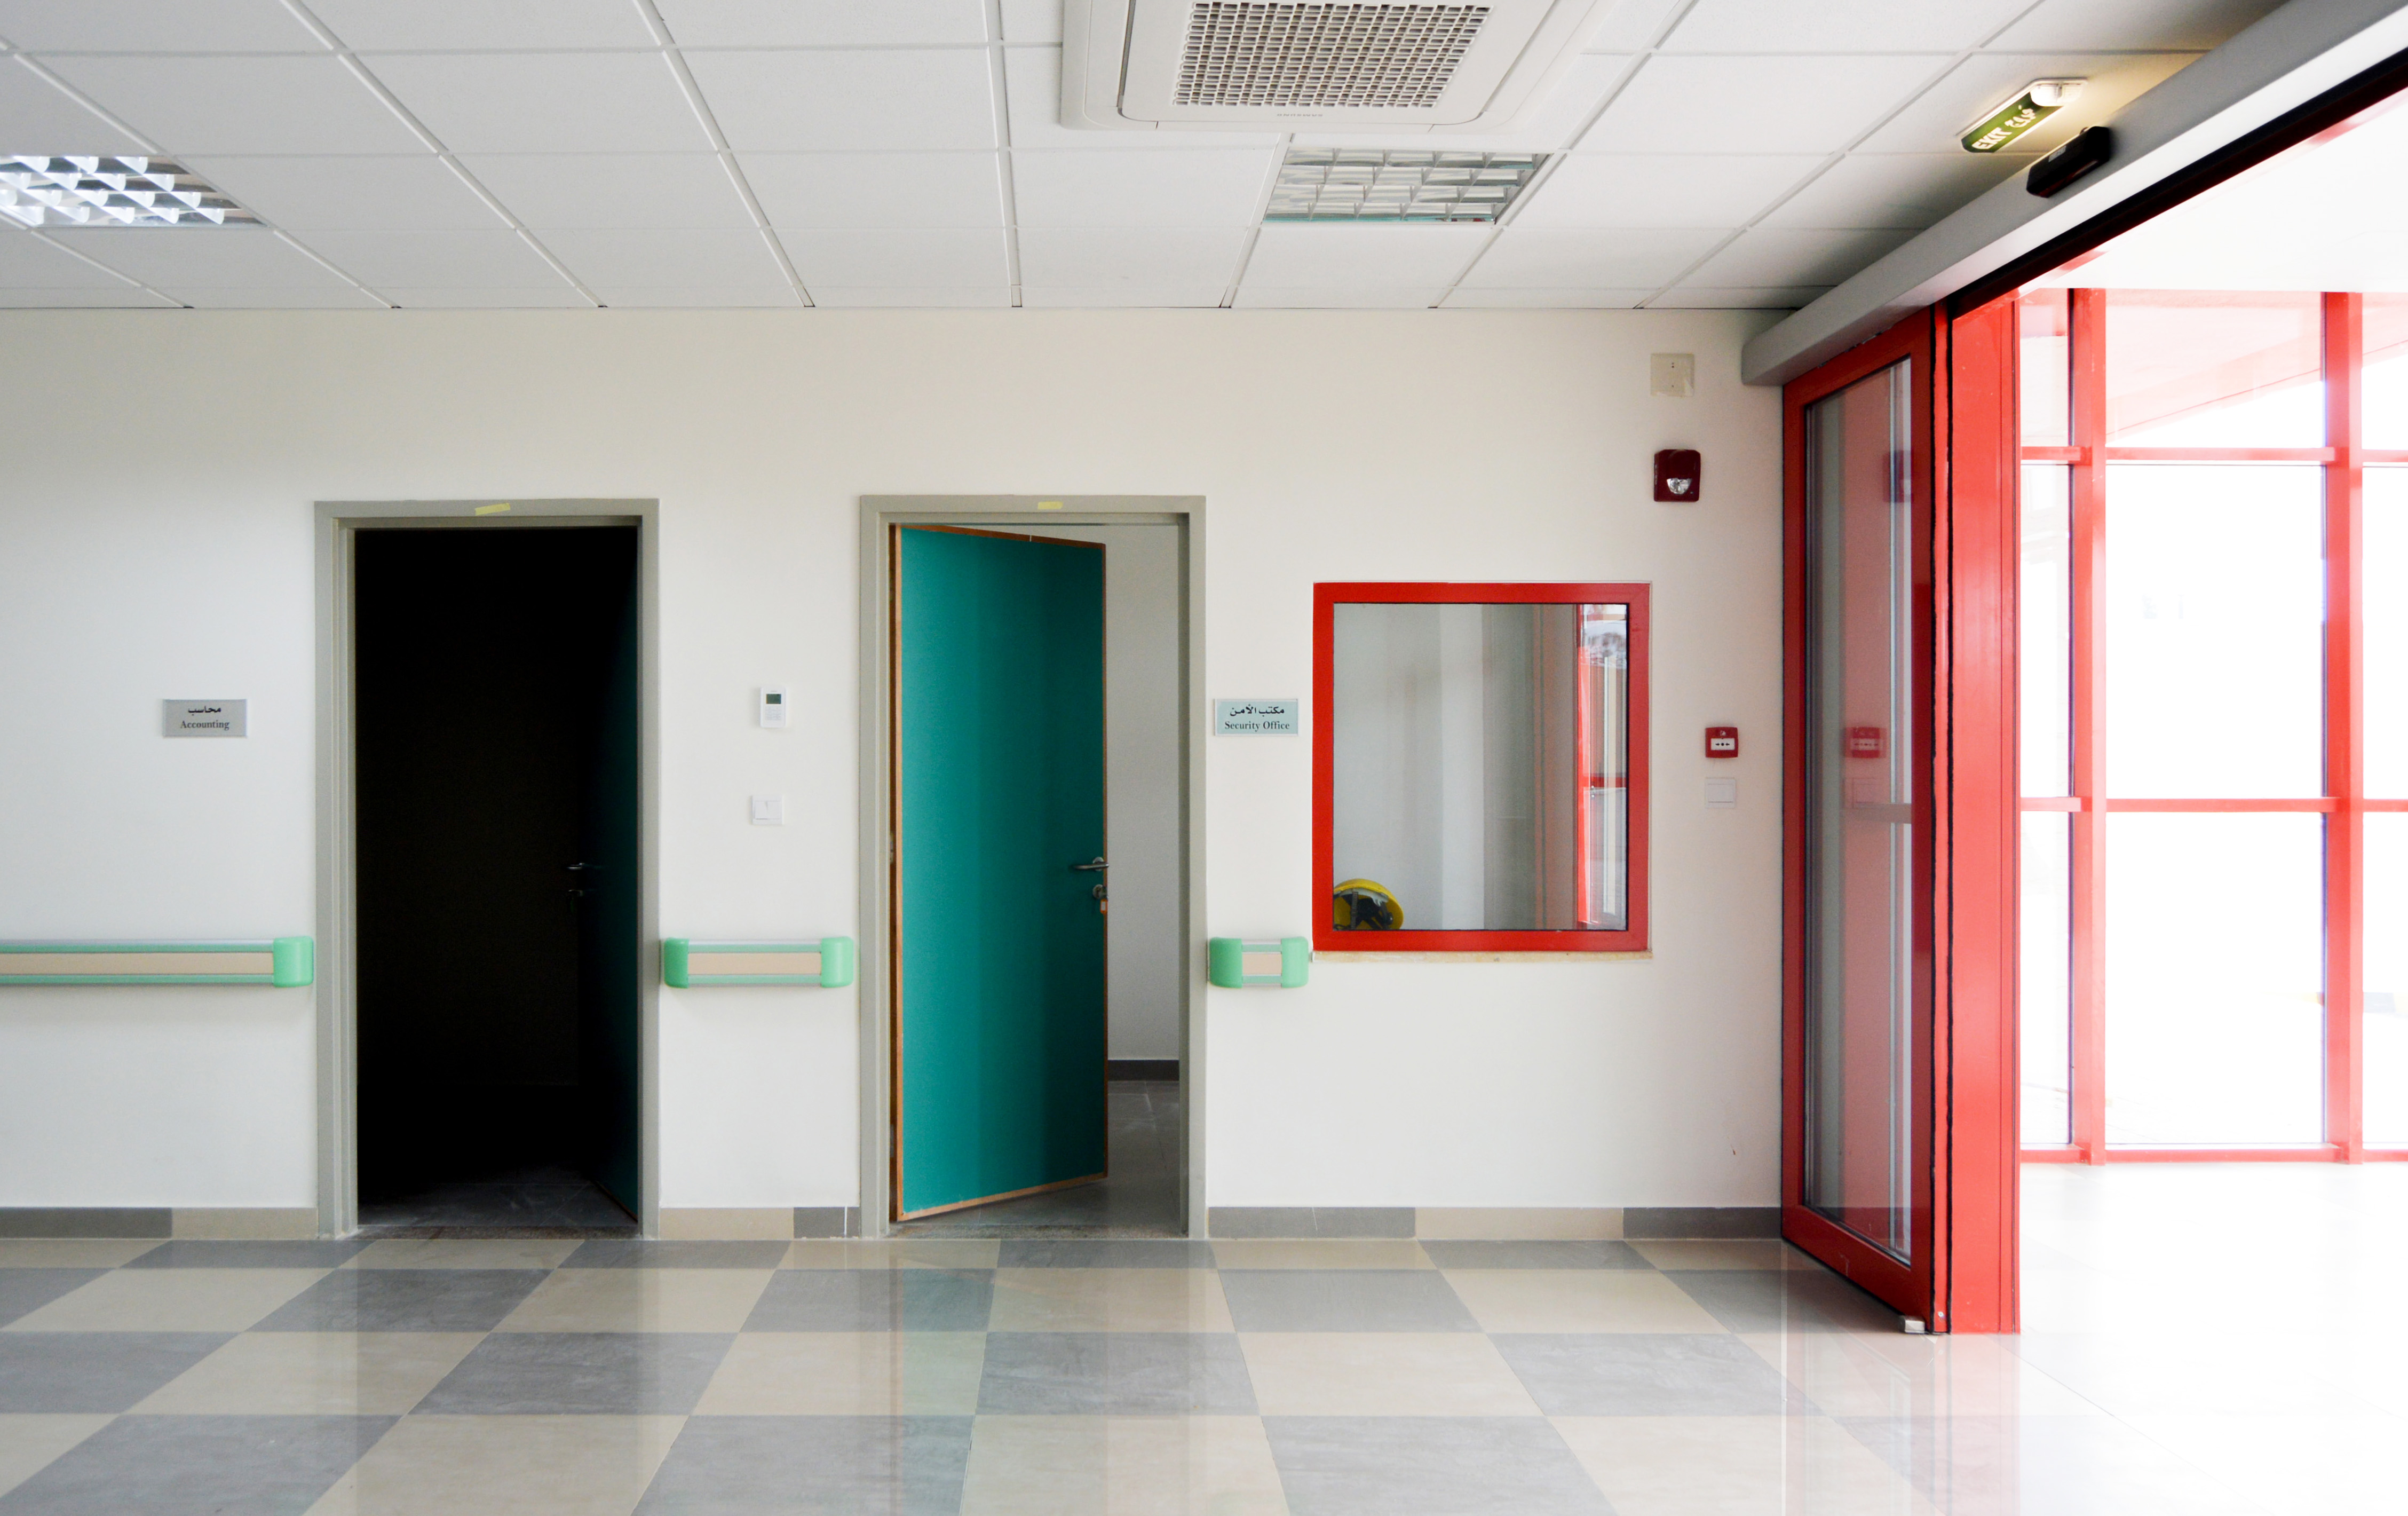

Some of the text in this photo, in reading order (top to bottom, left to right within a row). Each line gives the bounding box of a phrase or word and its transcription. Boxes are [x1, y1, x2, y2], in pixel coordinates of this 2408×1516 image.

[2005, 105, 2037, 128] مخرج
[1971, 127, 2012, 149] EXIT
[188, 706, 221, 716] محاسب
[1230, 704, 1285, 717] مكتب الأمن
[180, 720, 230, 731] Accounting
[1225, 721, 1290, 732] Security Office
